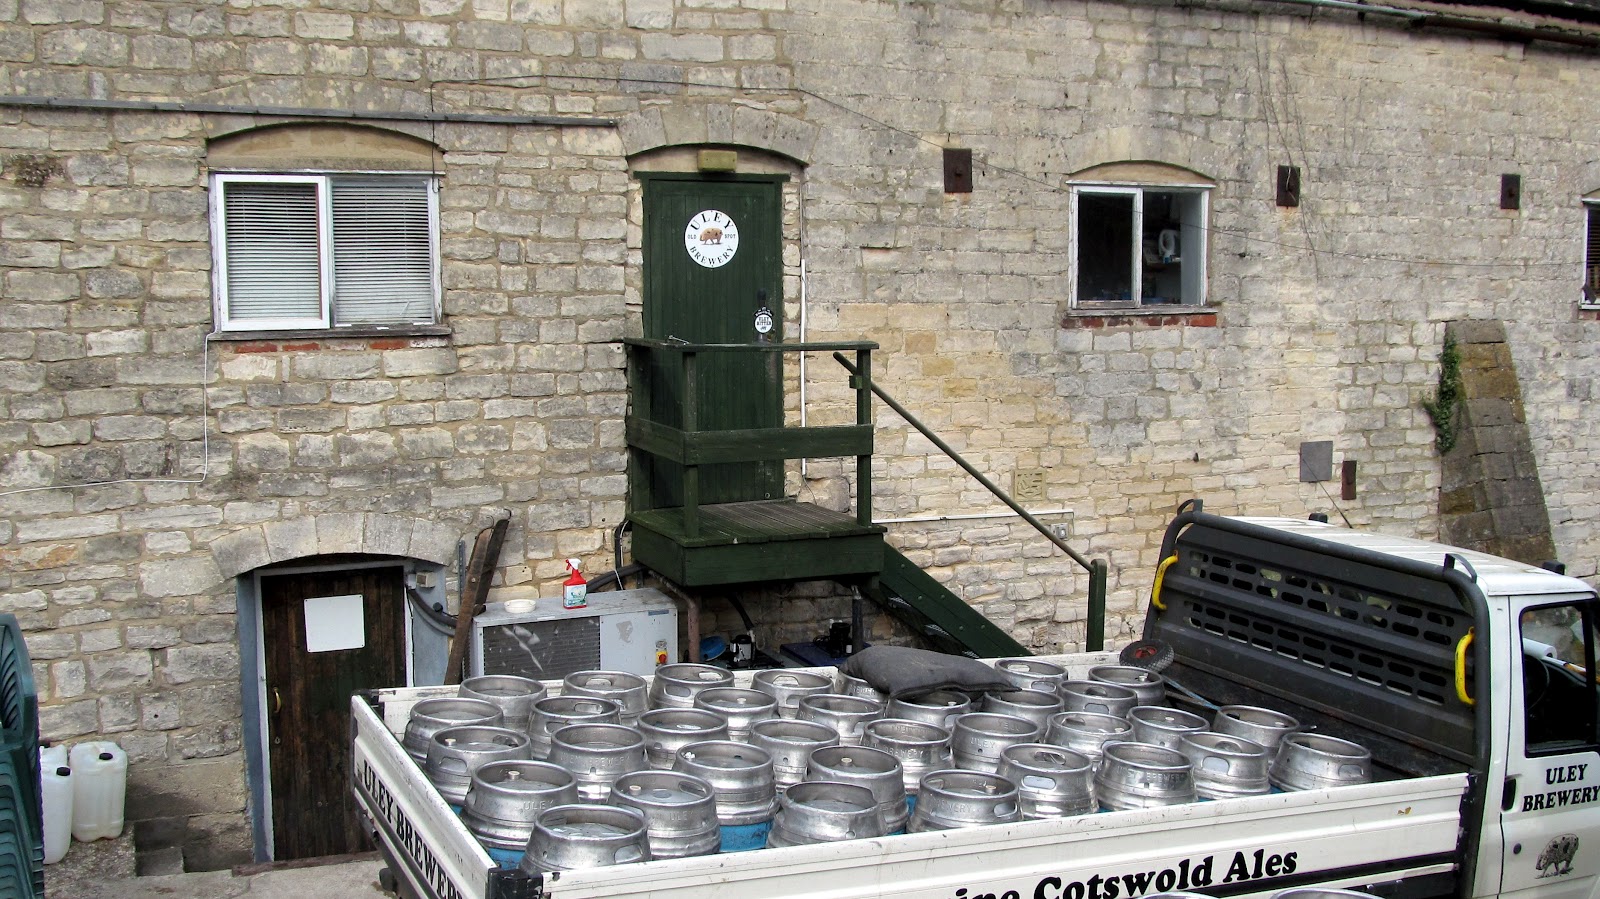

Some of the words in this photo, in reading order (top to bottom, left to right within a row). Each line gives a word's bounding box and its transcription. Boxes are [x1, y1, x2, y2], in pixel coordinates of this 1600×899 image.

[690, 212, 734, 230] ULEY
[689, 245, 734, 265] BREWERY
[884, 747, 924, 759] BREWERY
[970, 737, 996, 749] ULEY
[1546, 764, 1588, 785] ULEY
[363, 759, 394, 824] ULEY
[1522, 786, 1600, 813] BREWERY
[523, 799, 554, 811] ULEY
[1034, 857, 1214, 899] Cotswold
[1223, 849, 1298, 883] Ales
